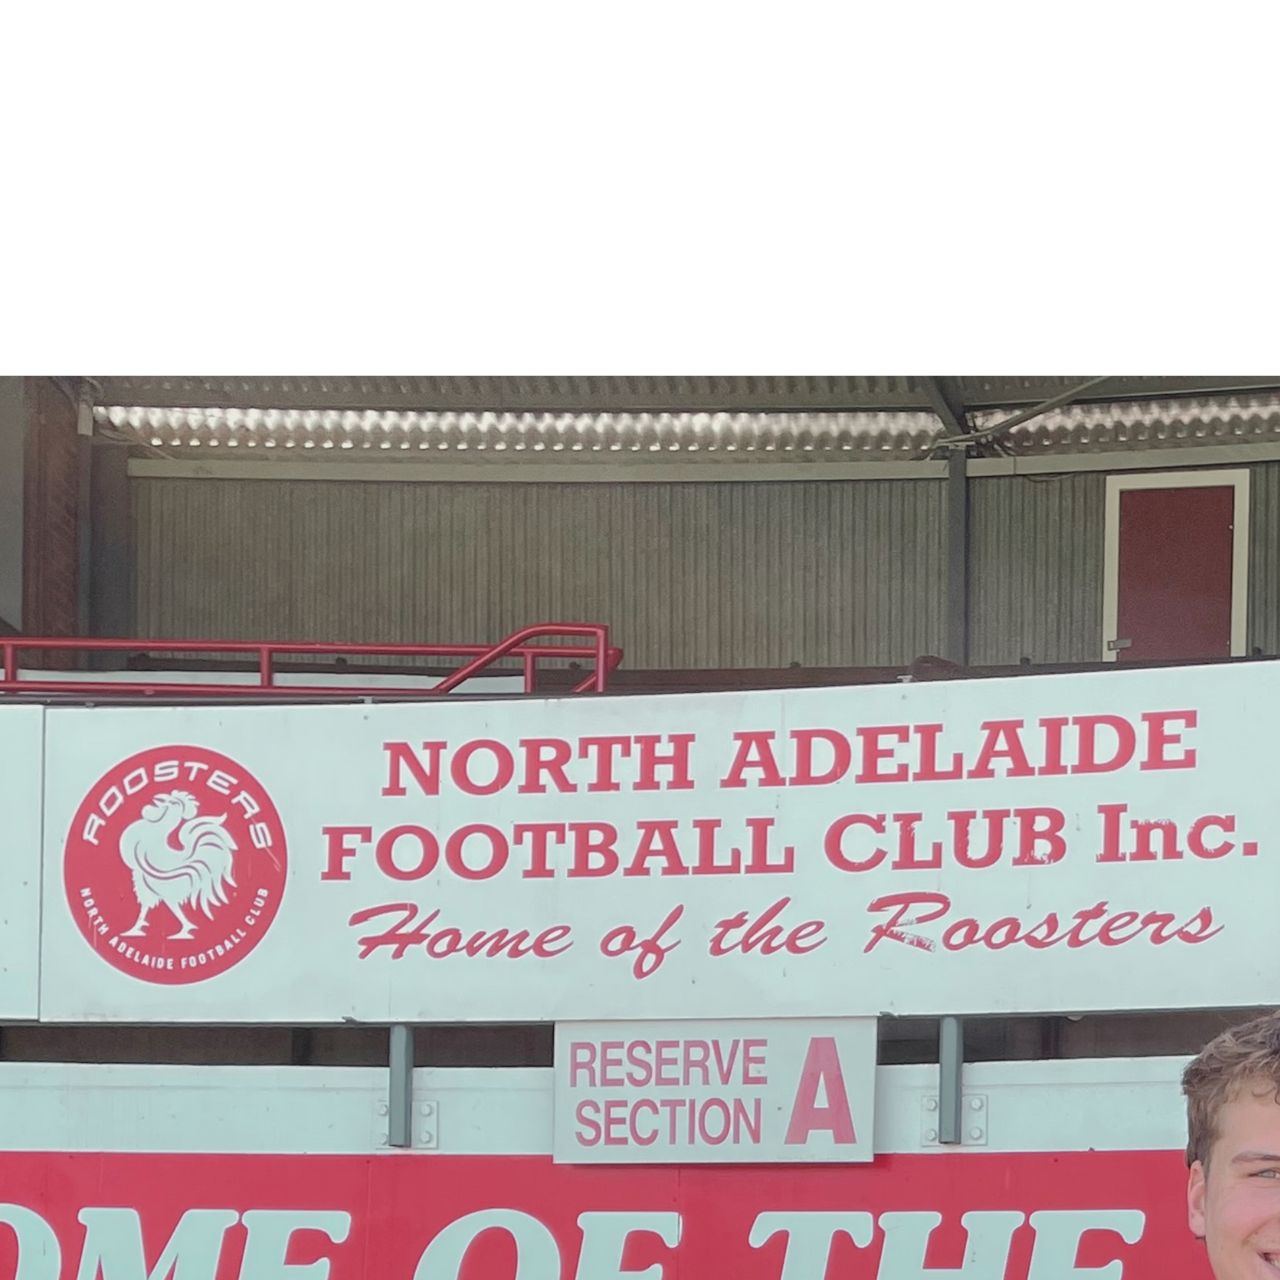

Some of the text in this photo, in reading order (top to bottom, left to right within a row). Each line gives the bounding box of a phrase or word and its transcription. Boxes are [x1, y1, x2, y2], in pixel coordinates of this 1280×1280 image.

[381, 709, 1198, 796] NORTH ADELAIDE
[82, 760, 273, 849] ROOSTERS
[320, 803, 1259, 881] FOOTBALL CLUB Inc.
[80, 887, 269, 970] NORTH ADELAIDE FOOTBALL CLUB
[348, 891, 1225, 980] Home of the Roosters
[569, 1039, 768, 1088] RESERVE
[784, 1037, 858, 1145] A
[575, 1097, 762, 1147] SECTION
